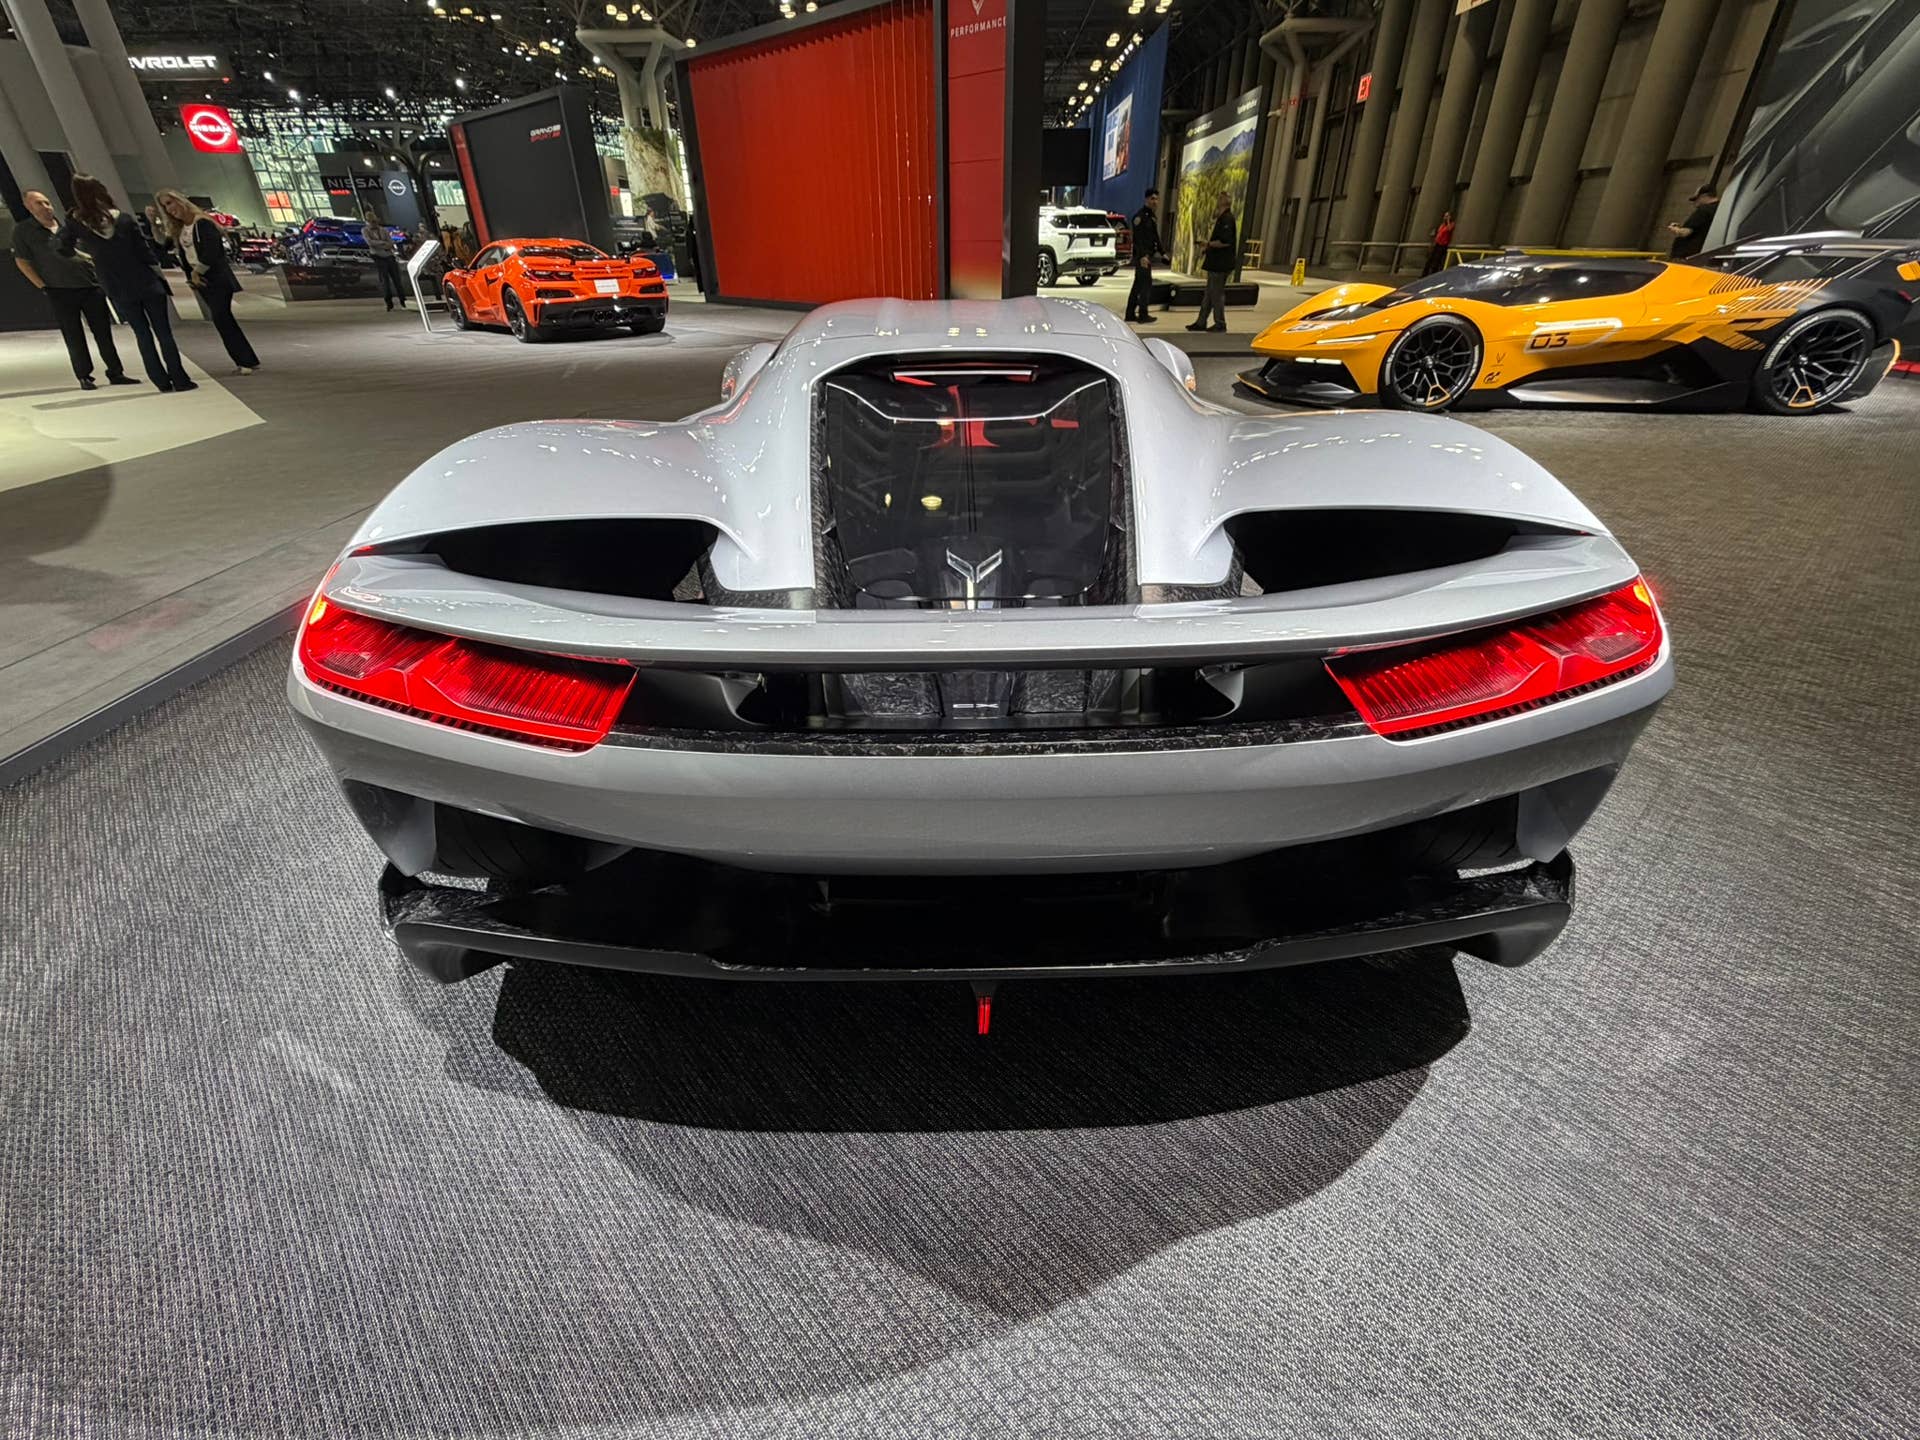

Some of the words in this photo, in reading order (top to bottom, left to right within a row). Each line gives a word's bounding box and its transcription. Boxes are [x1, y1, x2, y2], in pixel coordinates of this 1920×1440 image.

[128, 56, 217, 69] VROLET
[327, 178, 383, 189] NISSA
[1530, 332, 1570, 349] 03
